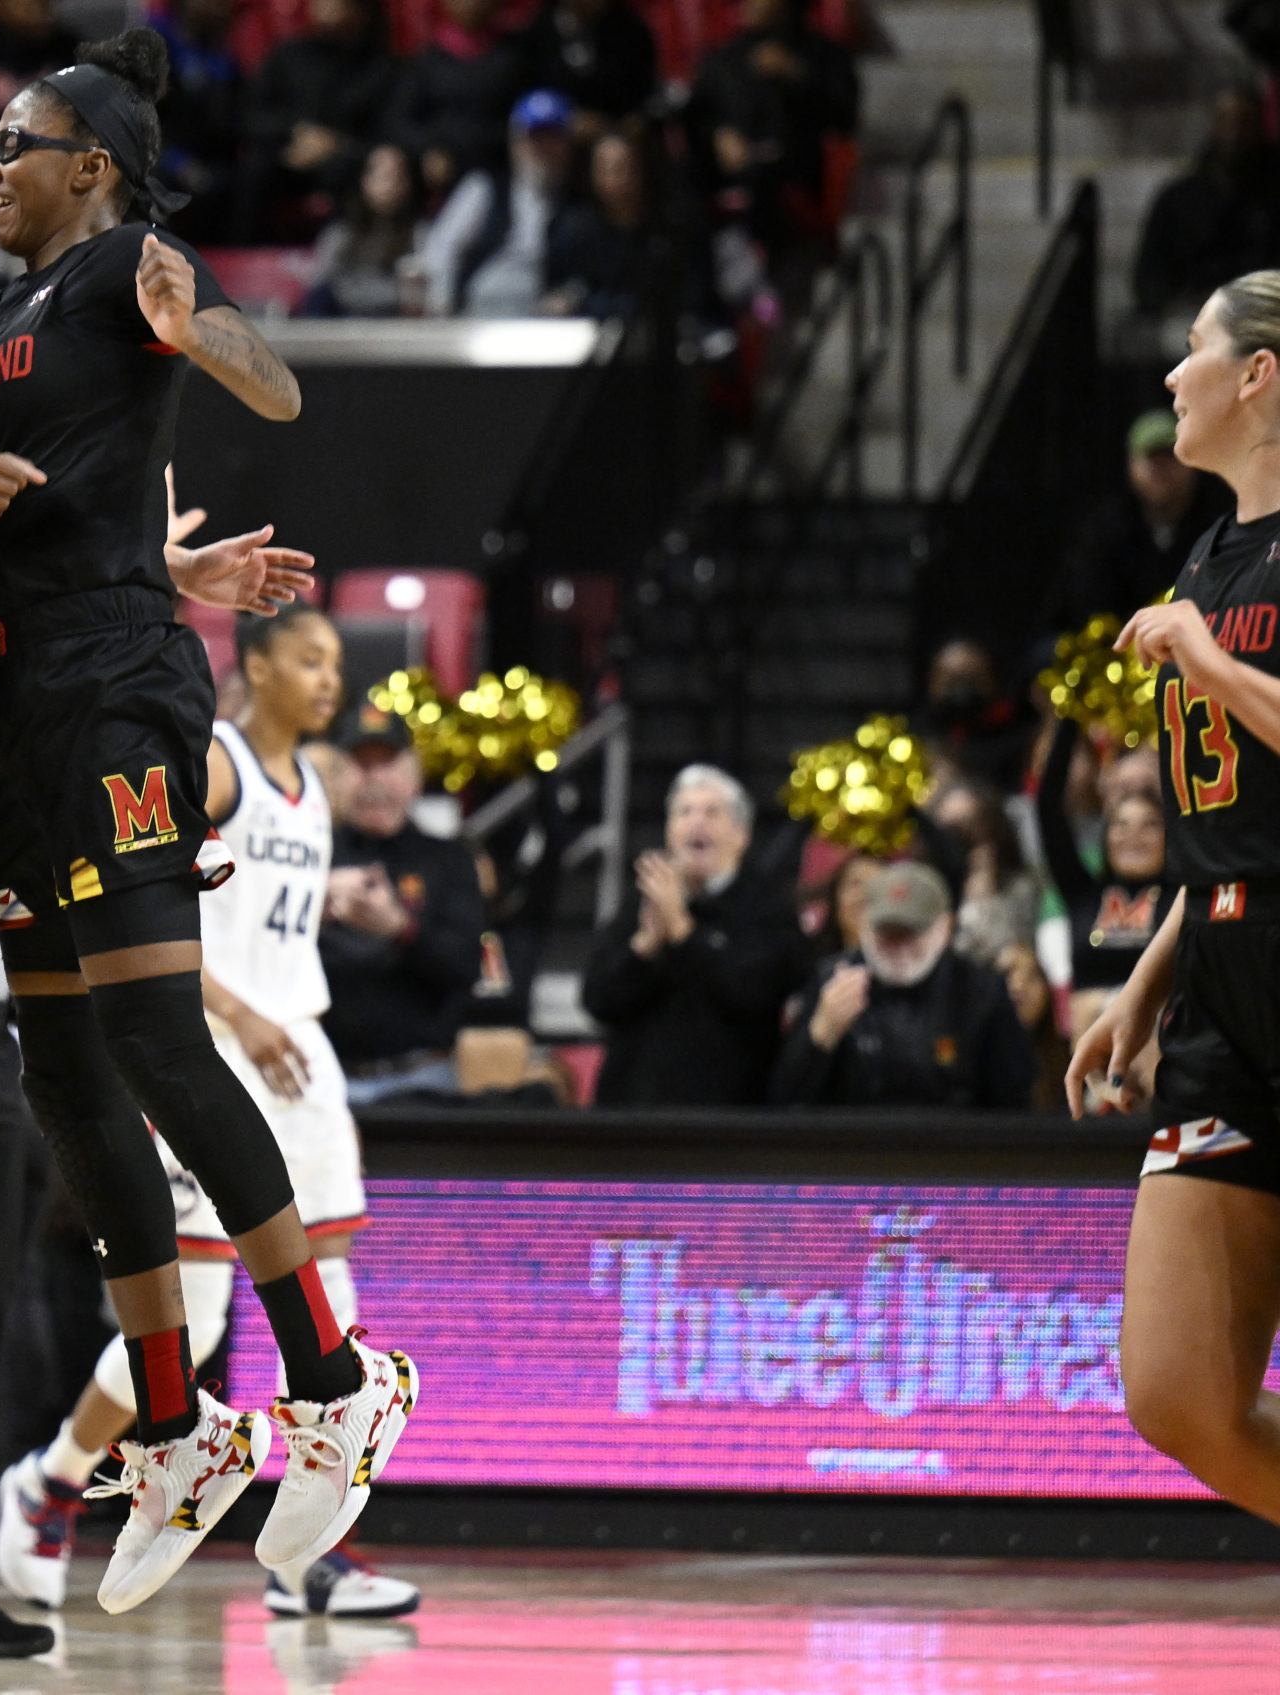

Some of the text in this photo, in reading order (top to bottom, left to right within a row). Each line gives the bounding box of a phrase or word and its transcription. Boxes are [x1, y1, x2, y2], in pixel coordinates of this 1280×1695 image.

[1164, 676, 1238, 816] 13
[101, 765, 178, 844] M
[1214, 882, 1237, 914] M
